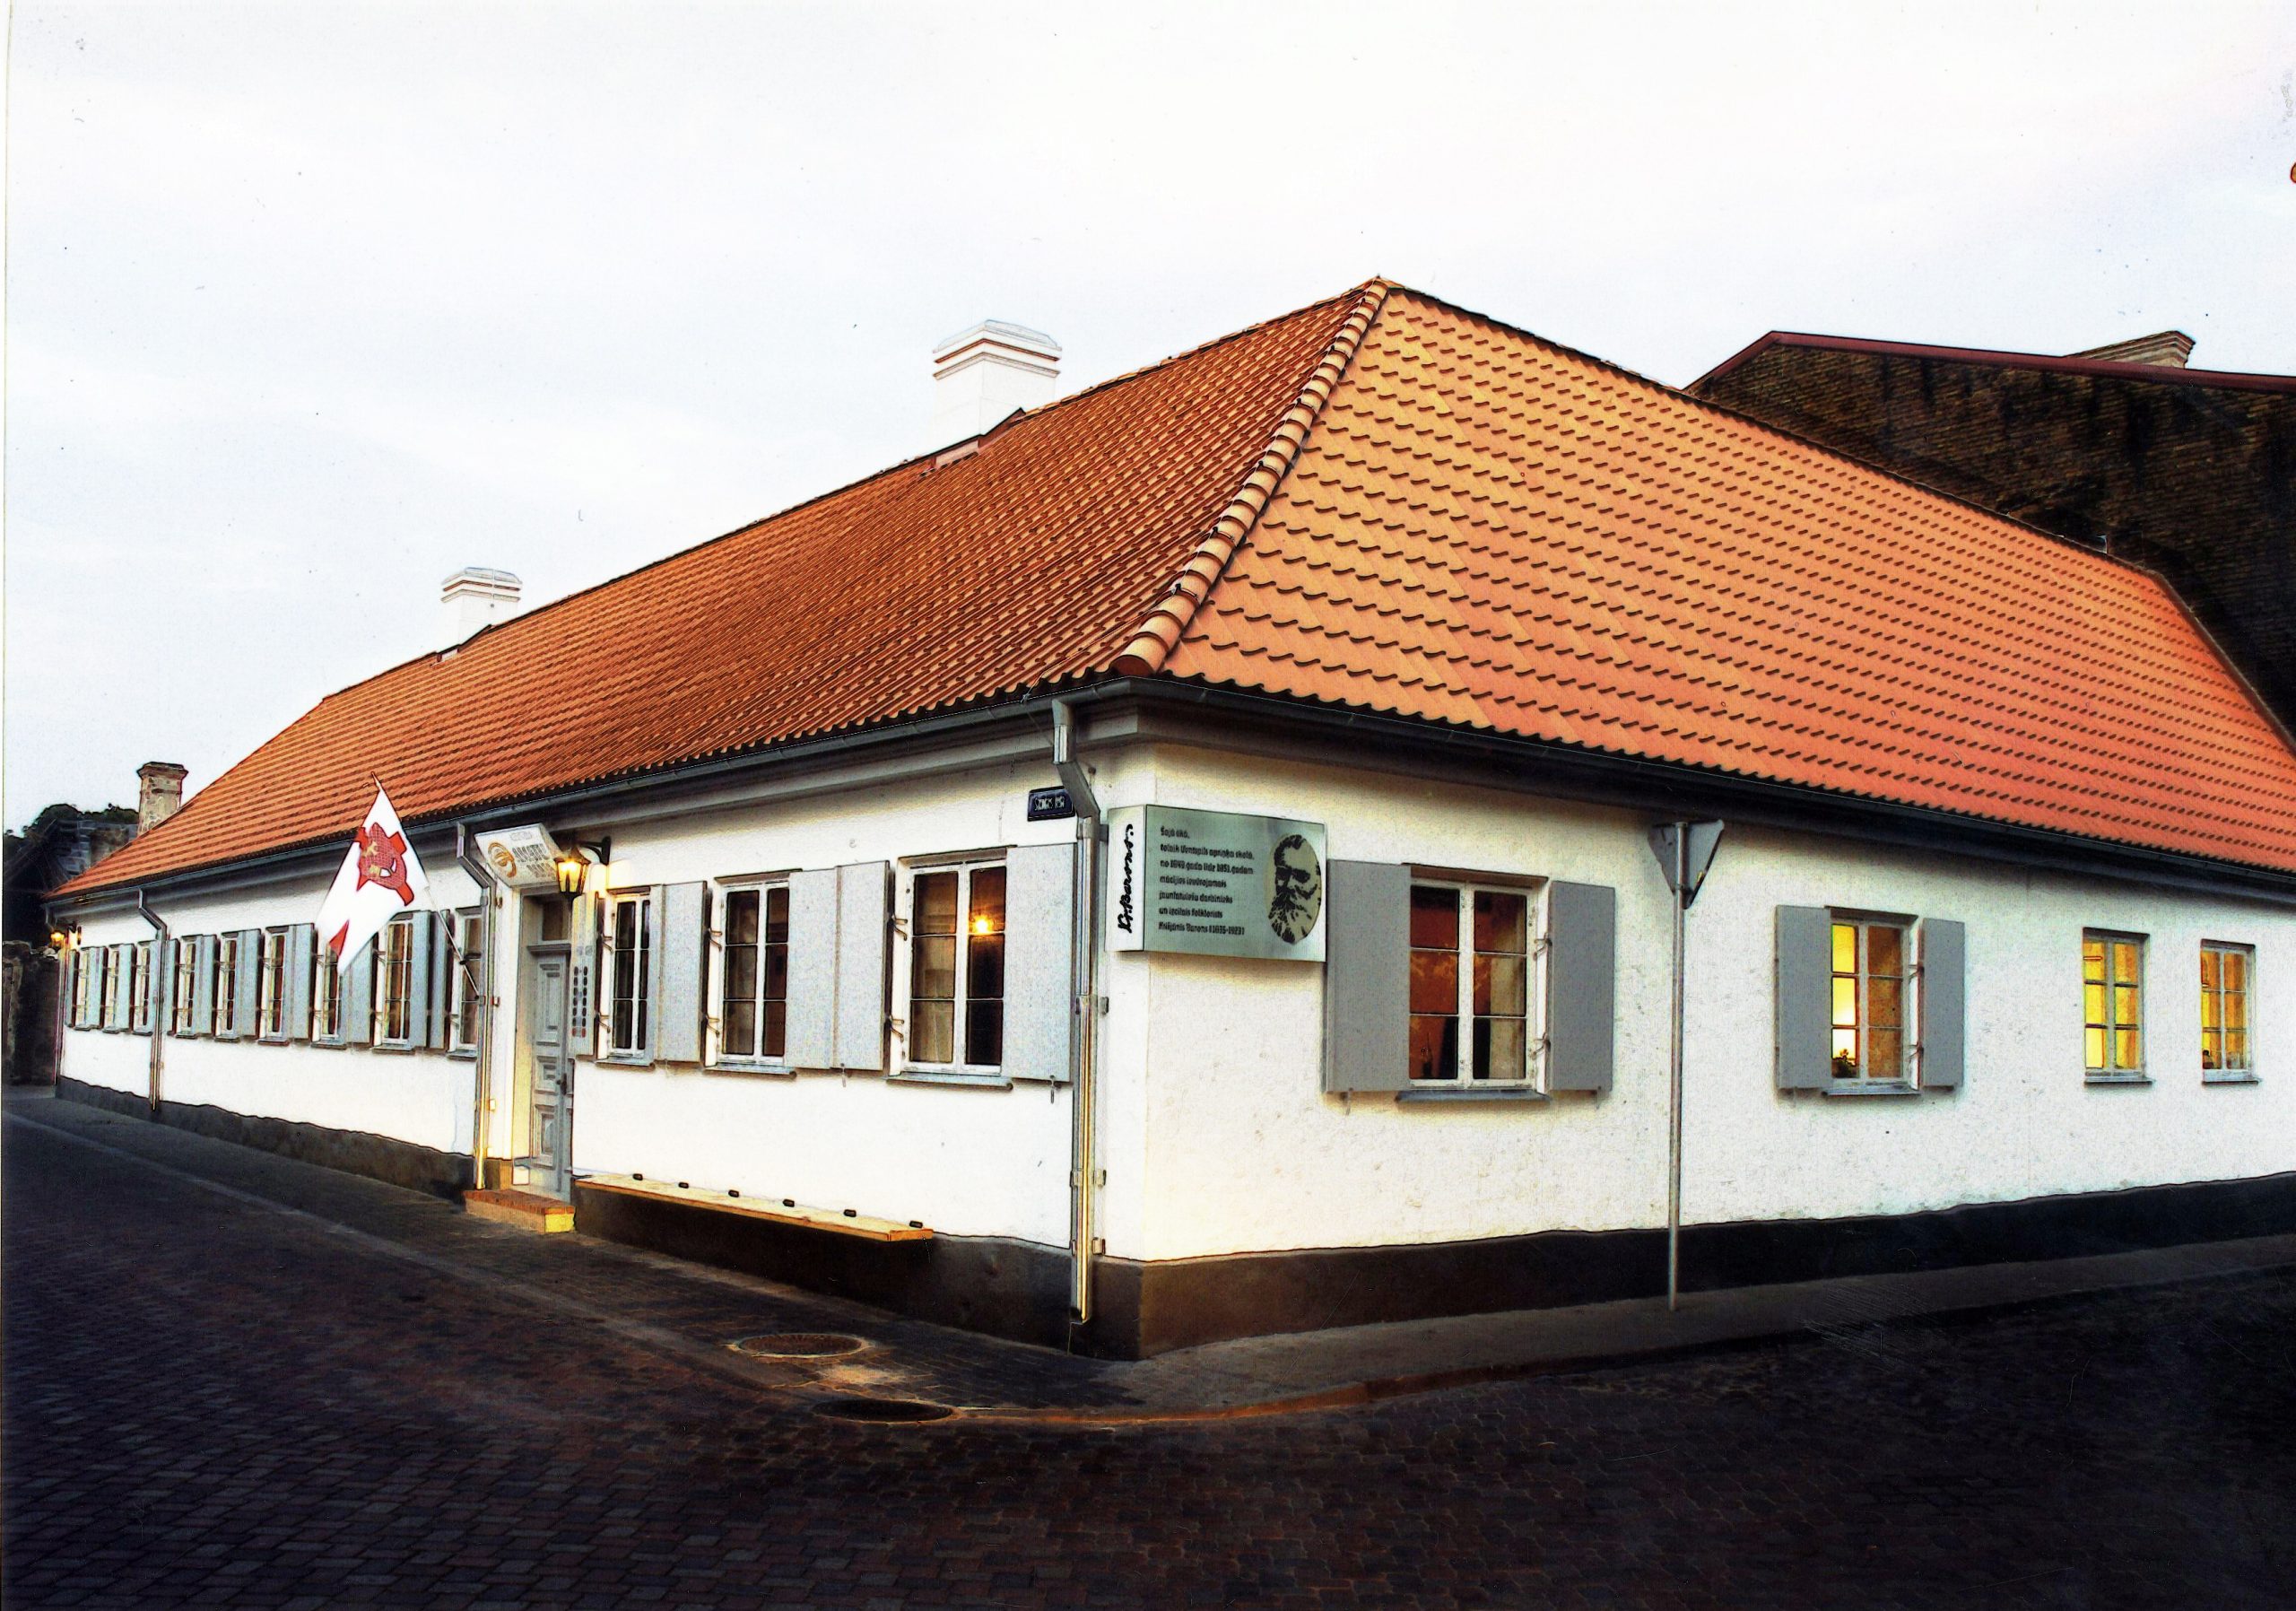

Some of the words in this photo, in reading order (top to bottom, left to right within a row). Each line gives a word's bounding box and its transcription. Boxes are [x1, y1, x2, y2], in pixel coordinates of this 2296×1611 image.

[1180, 845, 1208, 856] Ventspils
[1200, 893, 1233, 904] darbinieks
[1169, 908, 1191, 917] izcilais
[1191, 908, 1222, 919] folklorists
[1186, 922, 1208, 933] Barons
